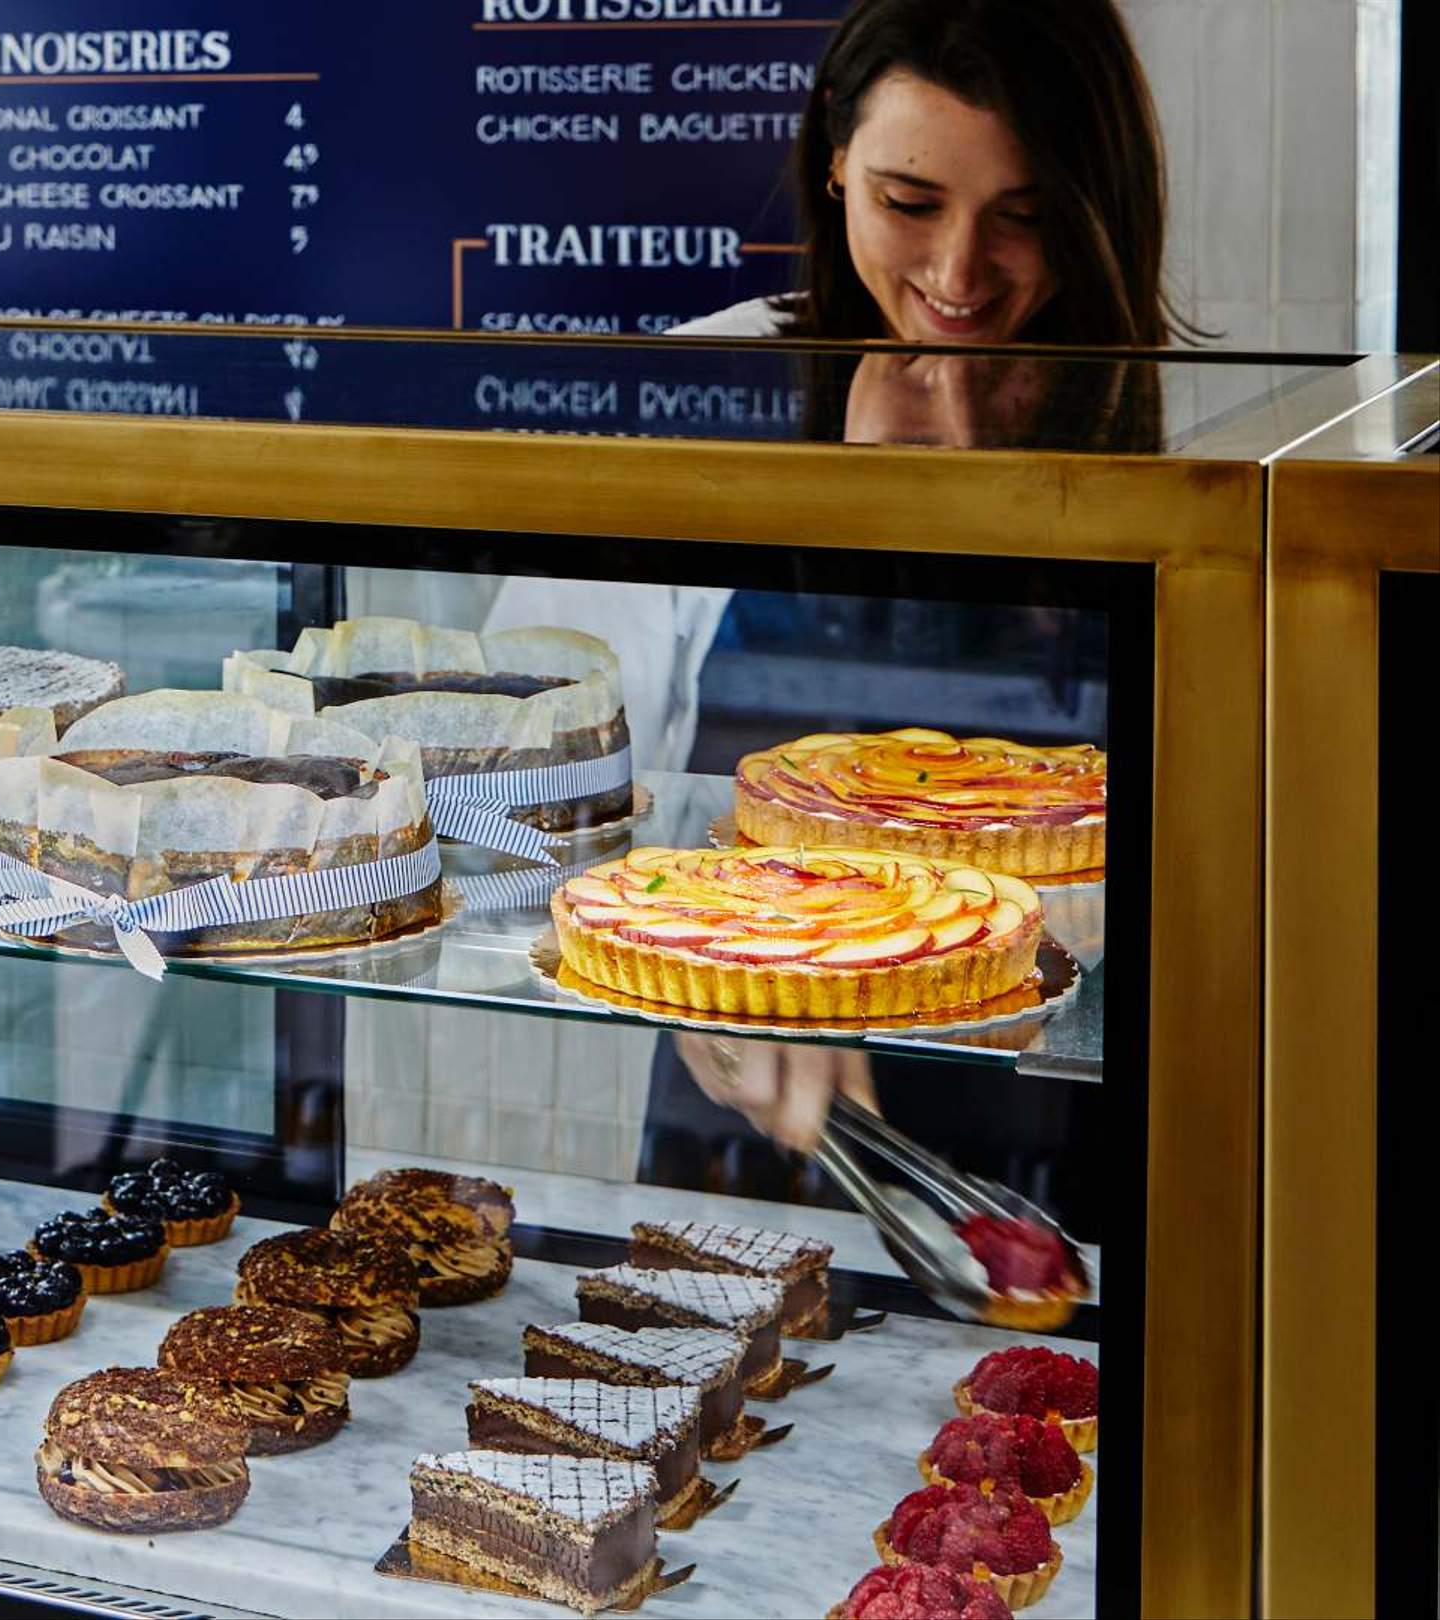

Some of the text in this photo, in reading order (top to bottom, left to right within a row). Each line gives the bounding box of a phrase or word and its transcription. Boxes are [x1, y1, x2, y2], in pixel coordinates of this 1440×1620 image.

[475, 62, 816, 94] ROTISSERIE CHICKEN
[65, 103, 205, 131] CROISSANT
[285, 103, 304, 130] 4
[476, 113, 804, 144] CHICKEN BAGUETTE
[7, 142, 155, 172] CHOCOLAT
[98, 183, 244, 209] CROISSANT
[23, 222, 116, 251] RAISIN
[486, 223, 743, 268] TRAITEUR
